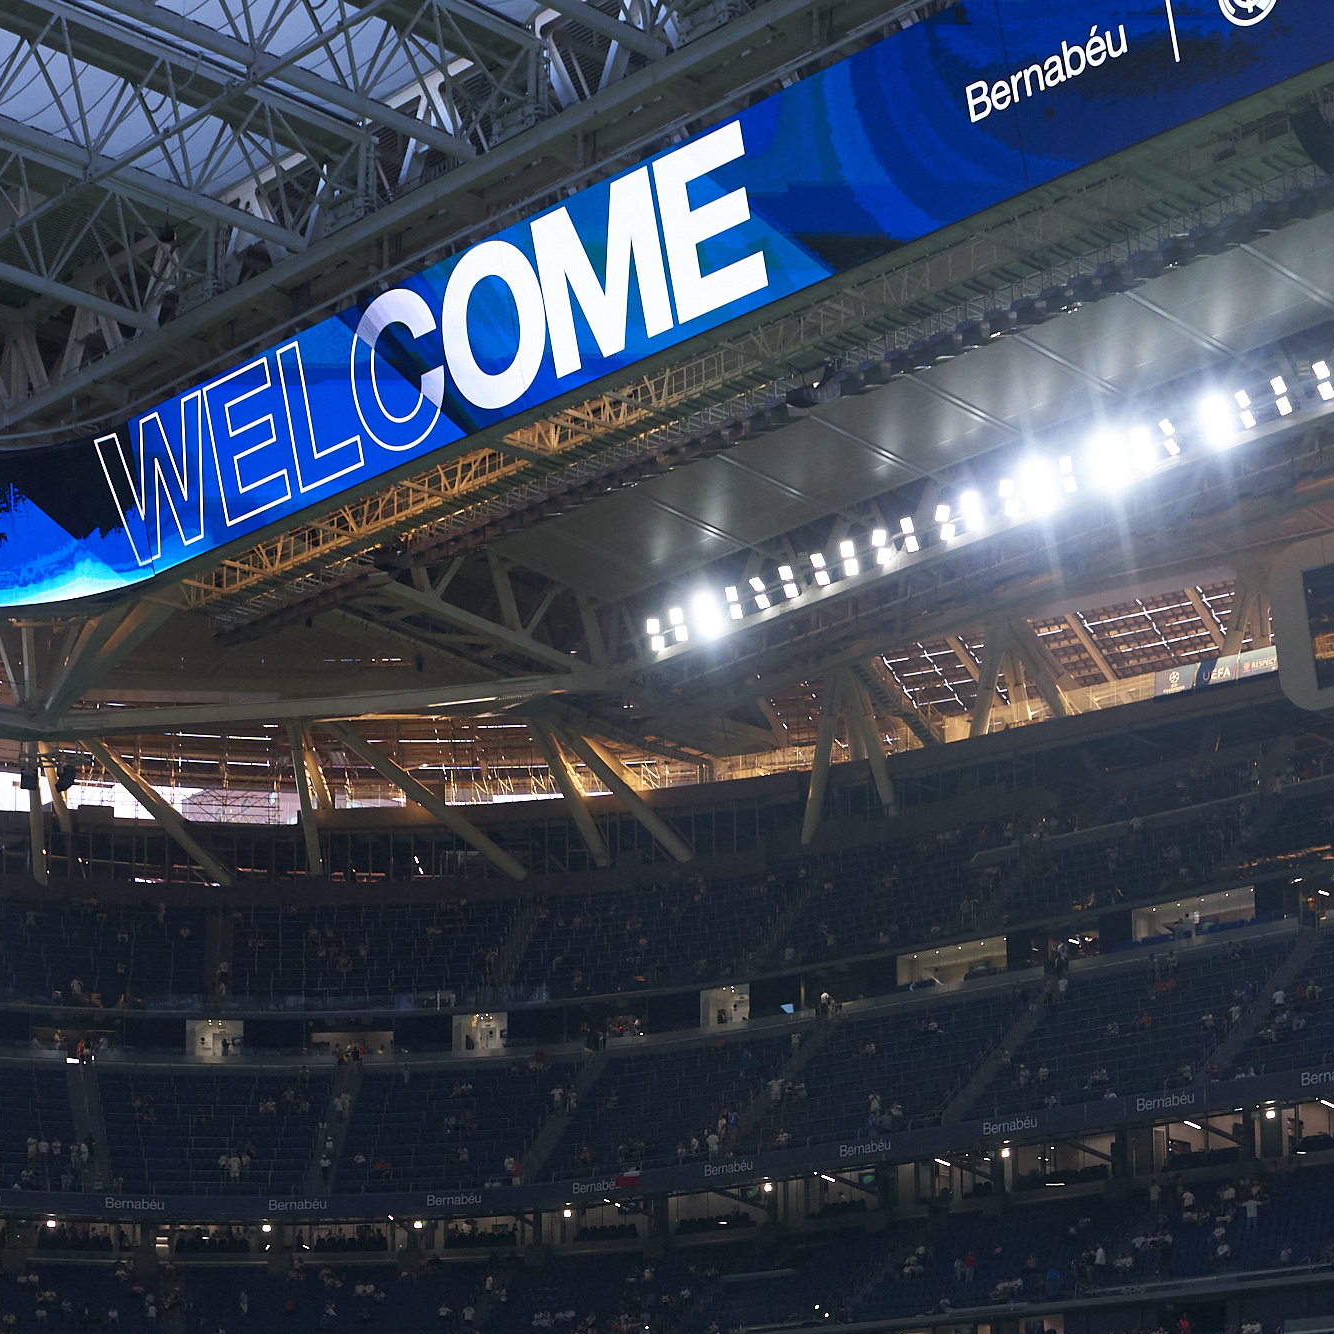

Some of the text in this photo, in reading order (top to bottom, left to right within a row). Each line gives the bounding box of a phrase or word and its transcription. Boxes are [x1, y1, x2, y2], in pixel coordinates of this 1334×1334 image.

[965, 24, 1128, 123] Bernabéu
[93, 119, 769, 566] WELCOME
[1202, 666, 1232, 681] UEFA
[1136, 1092, 1195, 1112] Bernabéu
[982, 1117, 1038, 1135] Bernabéu
[839, 1139, 891, 1158] Bernabéu
[704, 1159, 753, 1177] Bernabéu
[572, 1179, 616, 1195] Bernabé
[105, 1197, 165, 1211] Bernabéu
[268, 1198, 327, 1211] Bernabéu
[426, 1193, 482, 1206] Bernabéu
